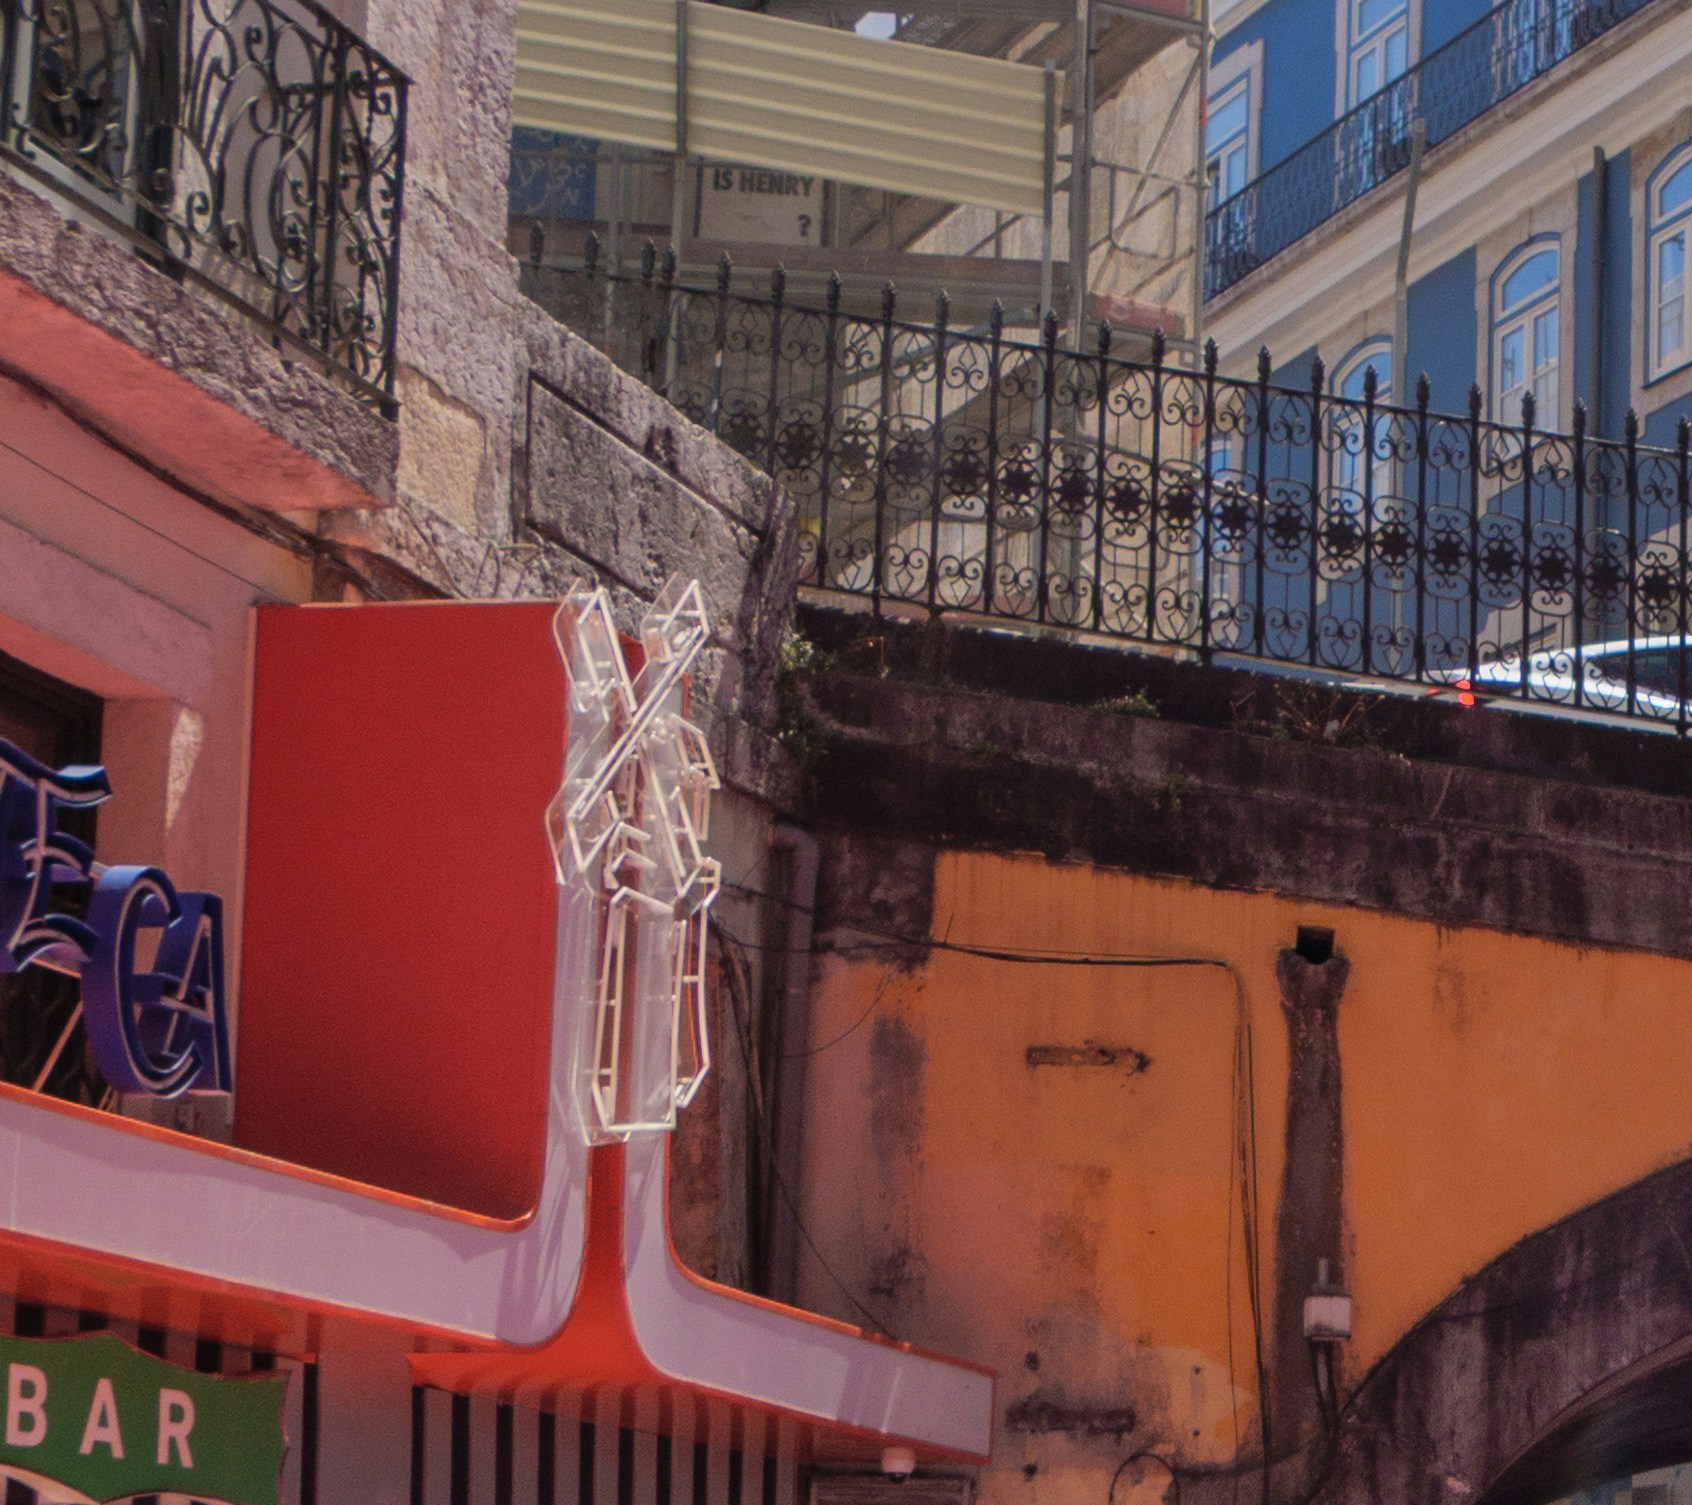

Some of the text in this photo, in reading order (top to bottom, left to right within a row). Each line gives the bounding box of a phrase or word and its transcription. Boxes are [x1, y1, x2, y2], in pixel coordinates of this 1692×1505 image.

[712, 168, 815, 197] IS HENRY
[4, 1363, 196, 1469] BAR
